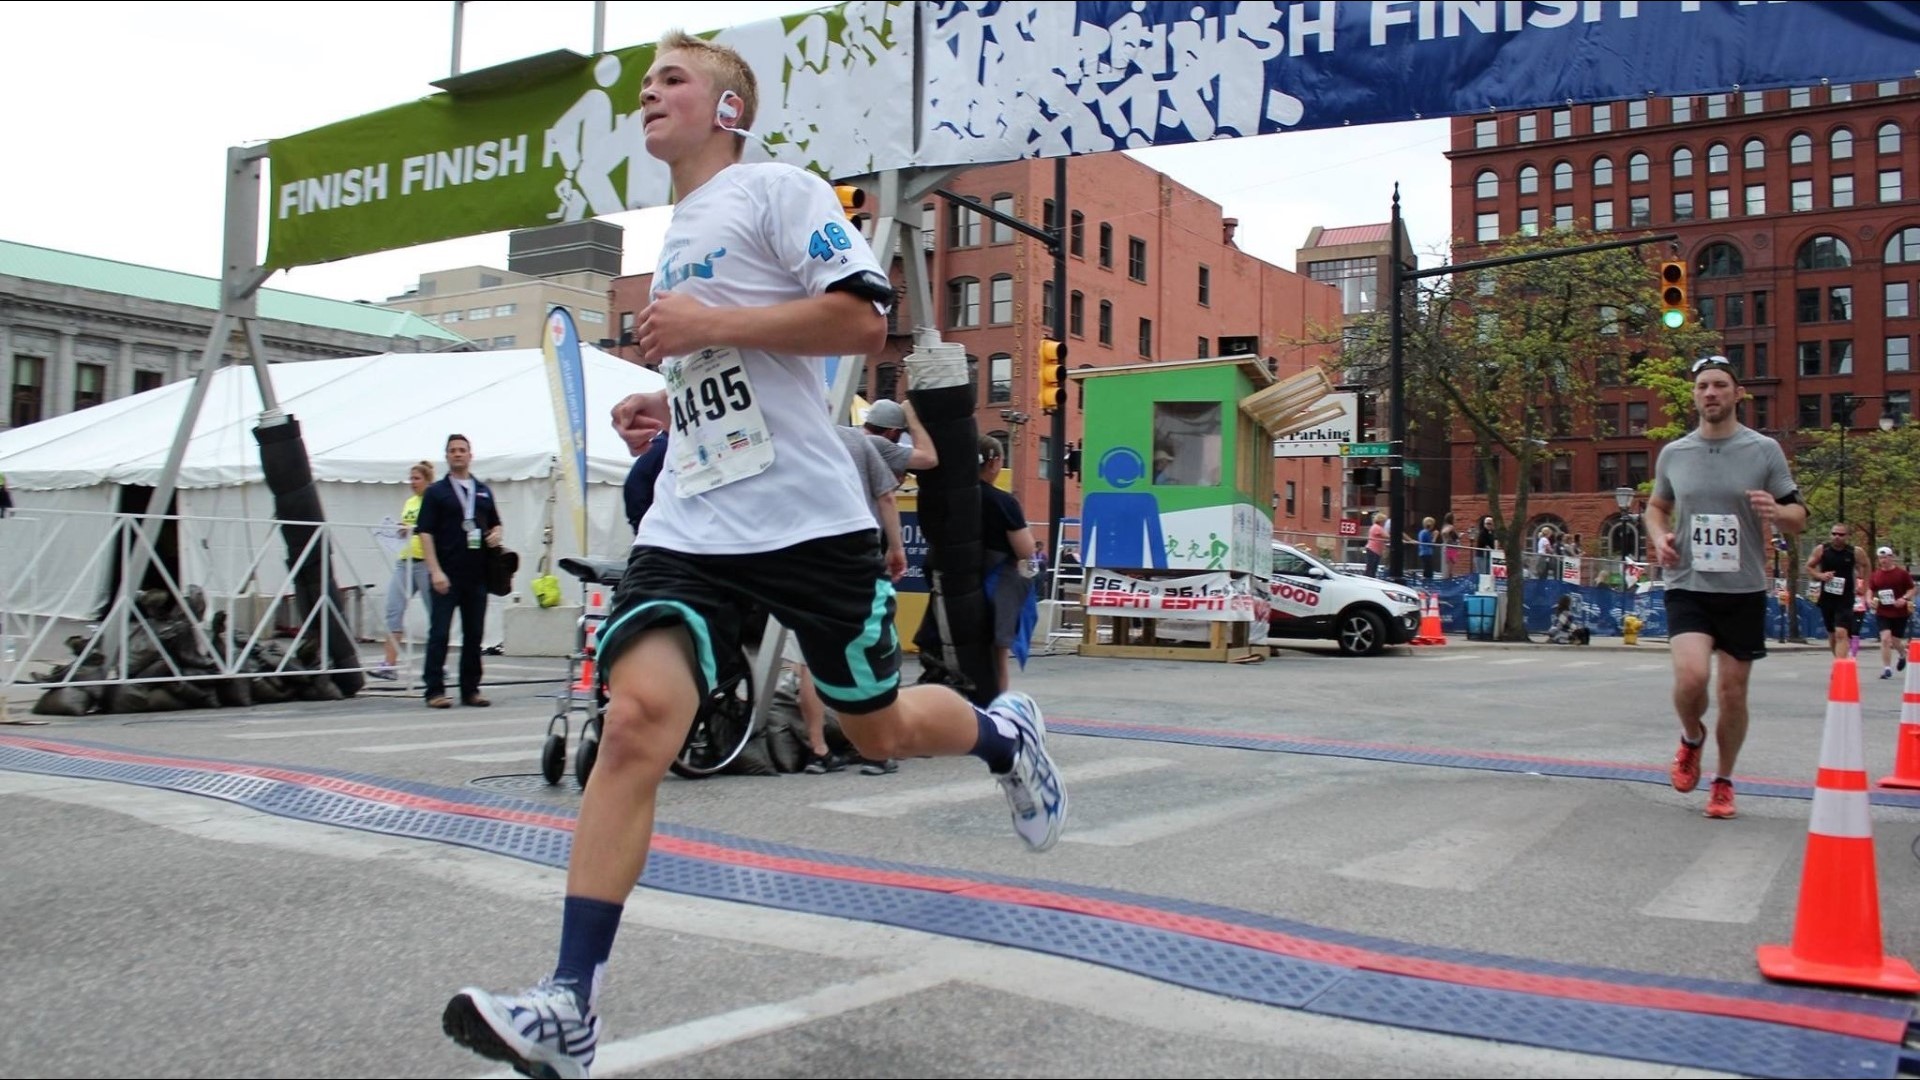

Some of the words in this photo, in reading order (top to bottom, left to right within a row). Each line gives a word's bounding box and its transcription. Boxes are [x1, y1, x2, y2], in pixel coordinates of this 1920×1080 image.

[278, 162, 388, 219] FINISH
[401, 134, 527, 195] FINISH
[808, 222, 852, 262] 48
[673, 366, 752, 436] 4495
[1693, 527, 1738, 546] 4163
[1093, 576, 1137, 594] 96.1
[1164, 584, 1207, 597] 96.1
[1270, 582, 1319, 606] WOOD
[1089, 590, 1150, 608] ESPN
[1161, 595, 1225, 610] ESPN
